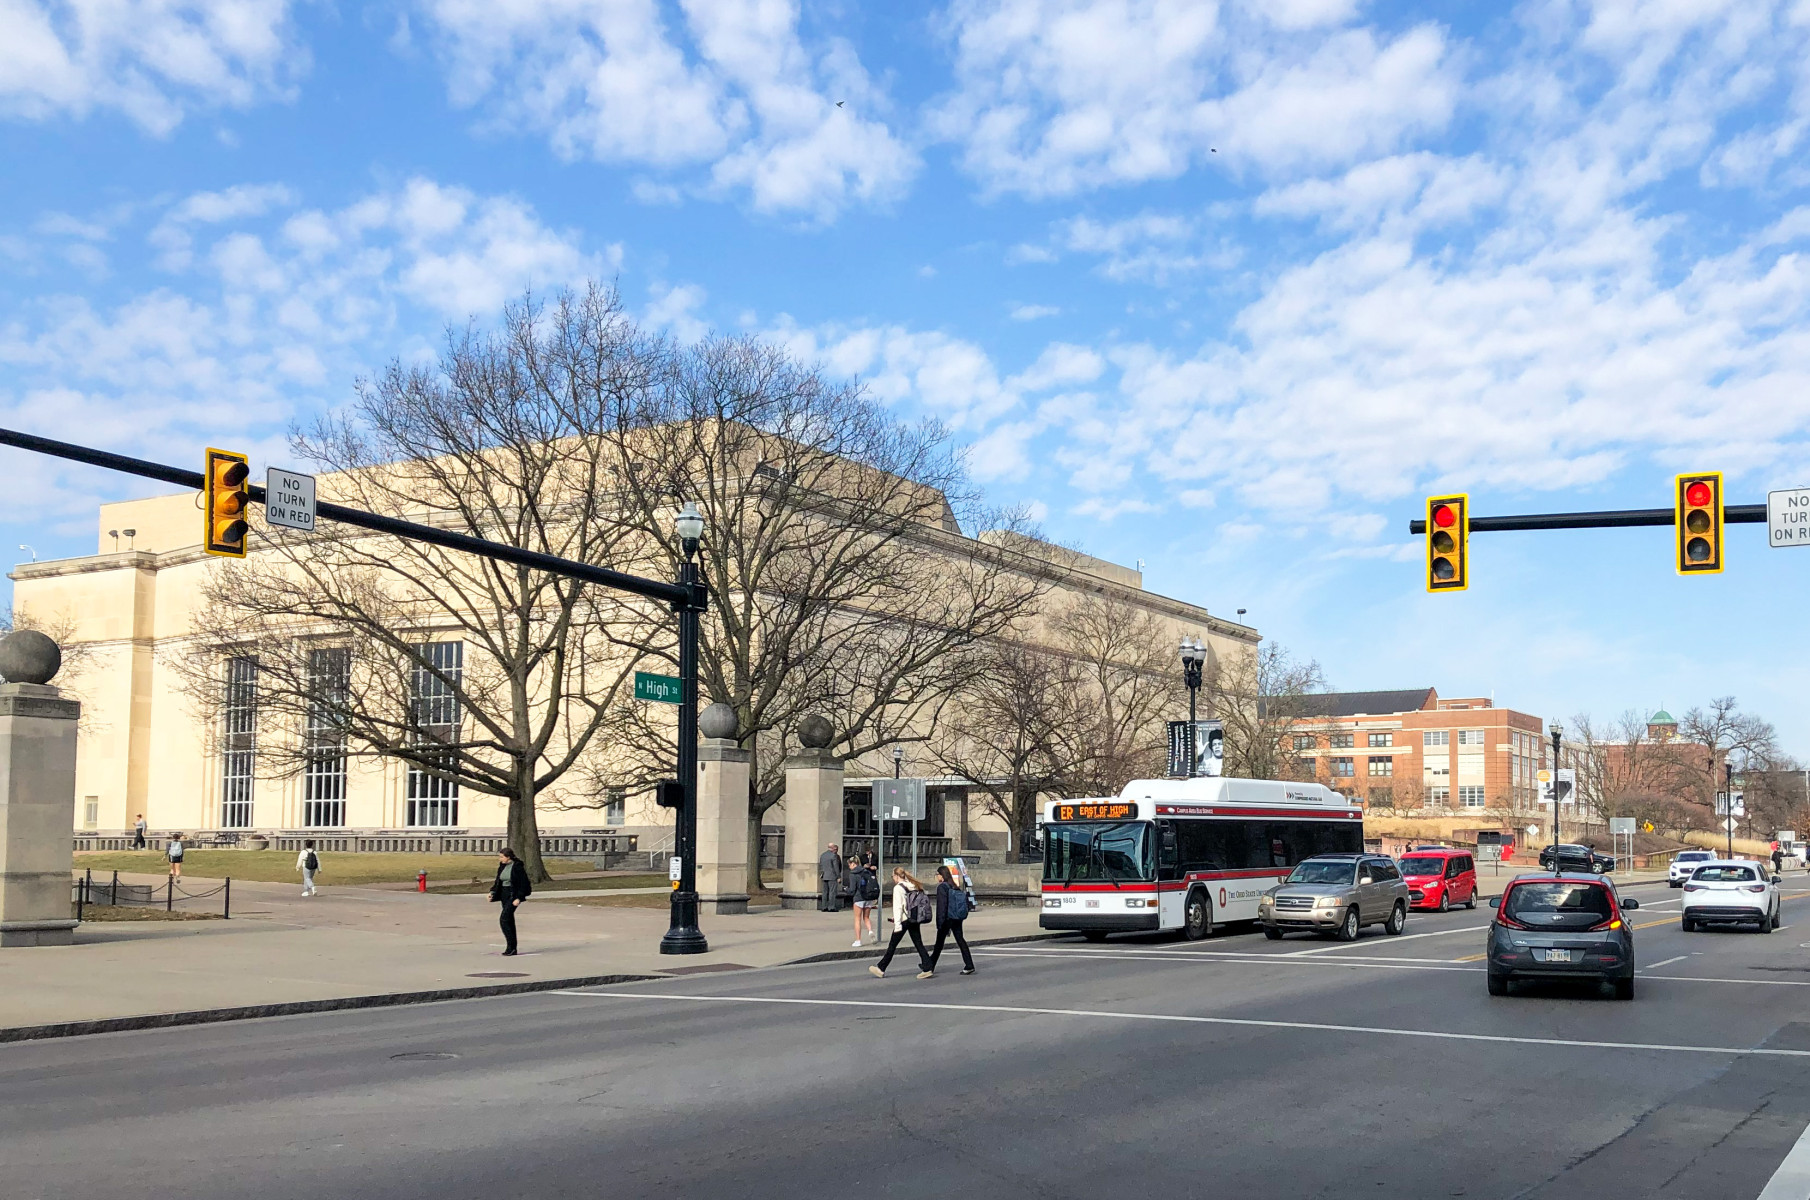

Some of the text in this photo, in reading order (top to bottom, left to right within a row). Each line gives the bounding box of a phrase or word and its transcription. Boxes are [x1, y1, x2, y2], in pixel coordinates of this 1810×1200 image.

[283, 477, 300, 491] NO
[277, 492, 306, 507] TURN
[1788, 496, 1810, 507] NO
[270, 506, 311, 524] ON RED
[1781, 512, 1810, 523] TUR
[1774, 528, 1793, 540] ON
[646, 680, 669, 699] High
[672, 686, 678, 694] St
[1061, 805, 1129, 820] ER EAST OF HIGH
